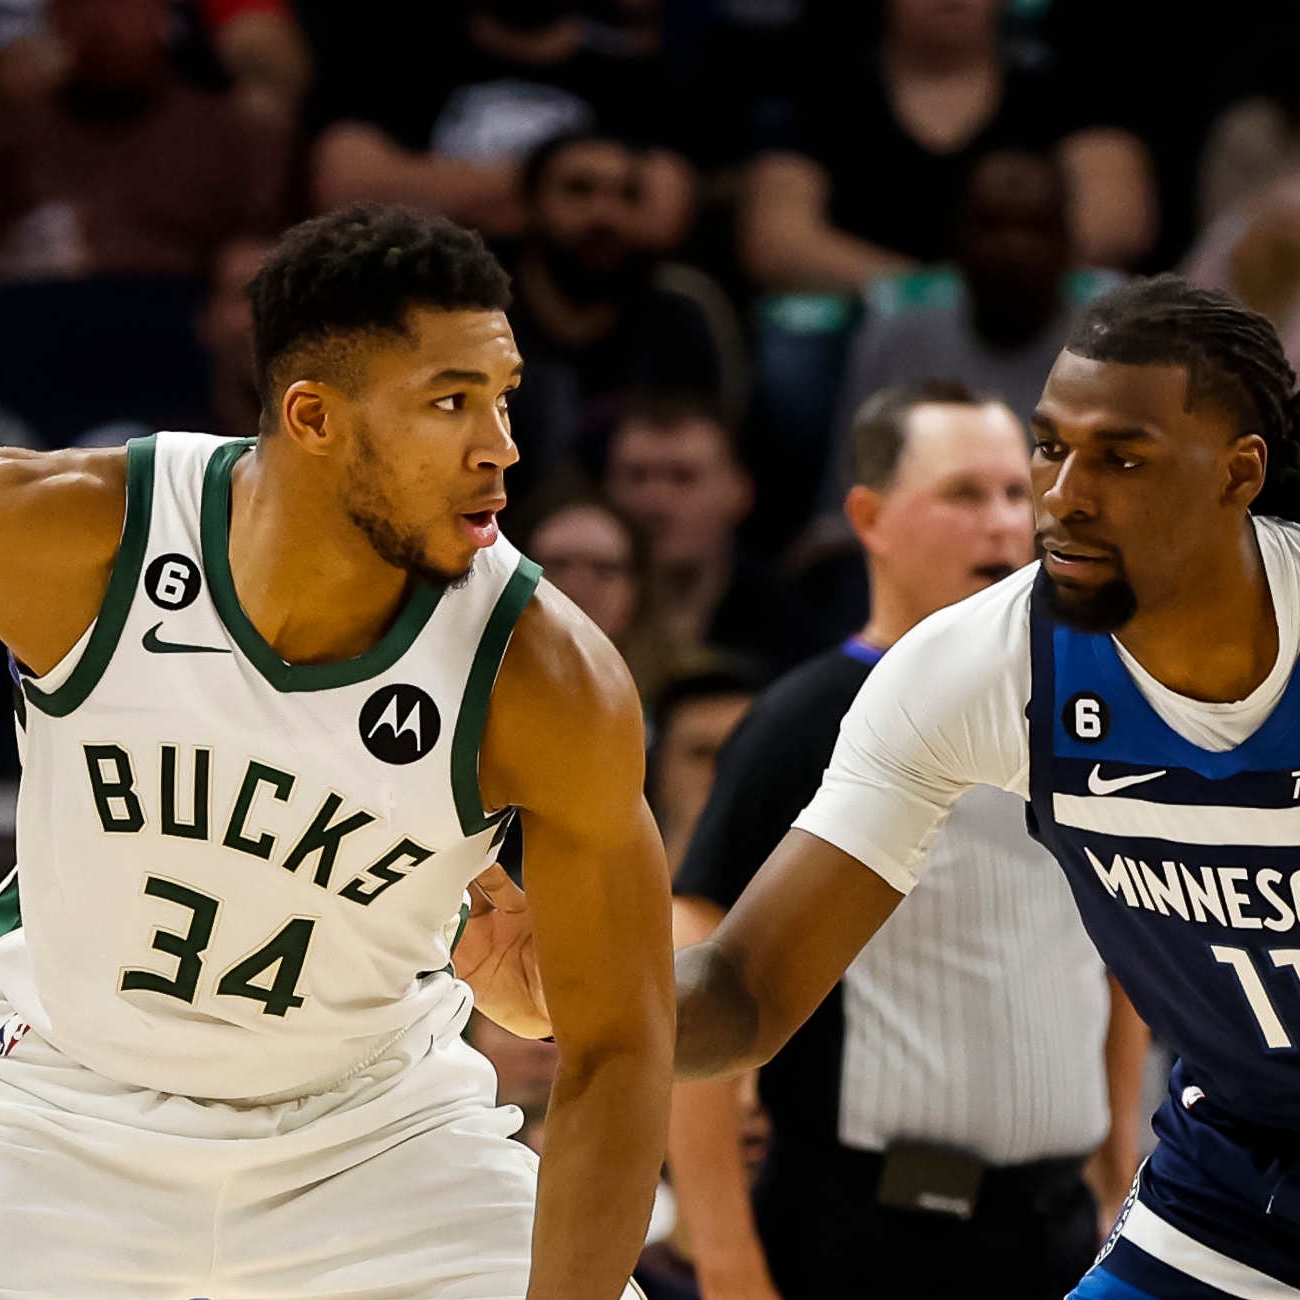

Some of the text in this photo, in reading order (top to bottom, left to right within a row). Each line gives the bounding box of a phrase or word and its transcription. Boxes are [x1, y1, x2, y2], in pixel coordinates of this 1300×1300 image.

[155, 561, 190, 604] 6
[1075, 698, 1101, 738] 6
[80, 741, 438, 907] BUCKS
[116, 870, 322, 1019] 34
